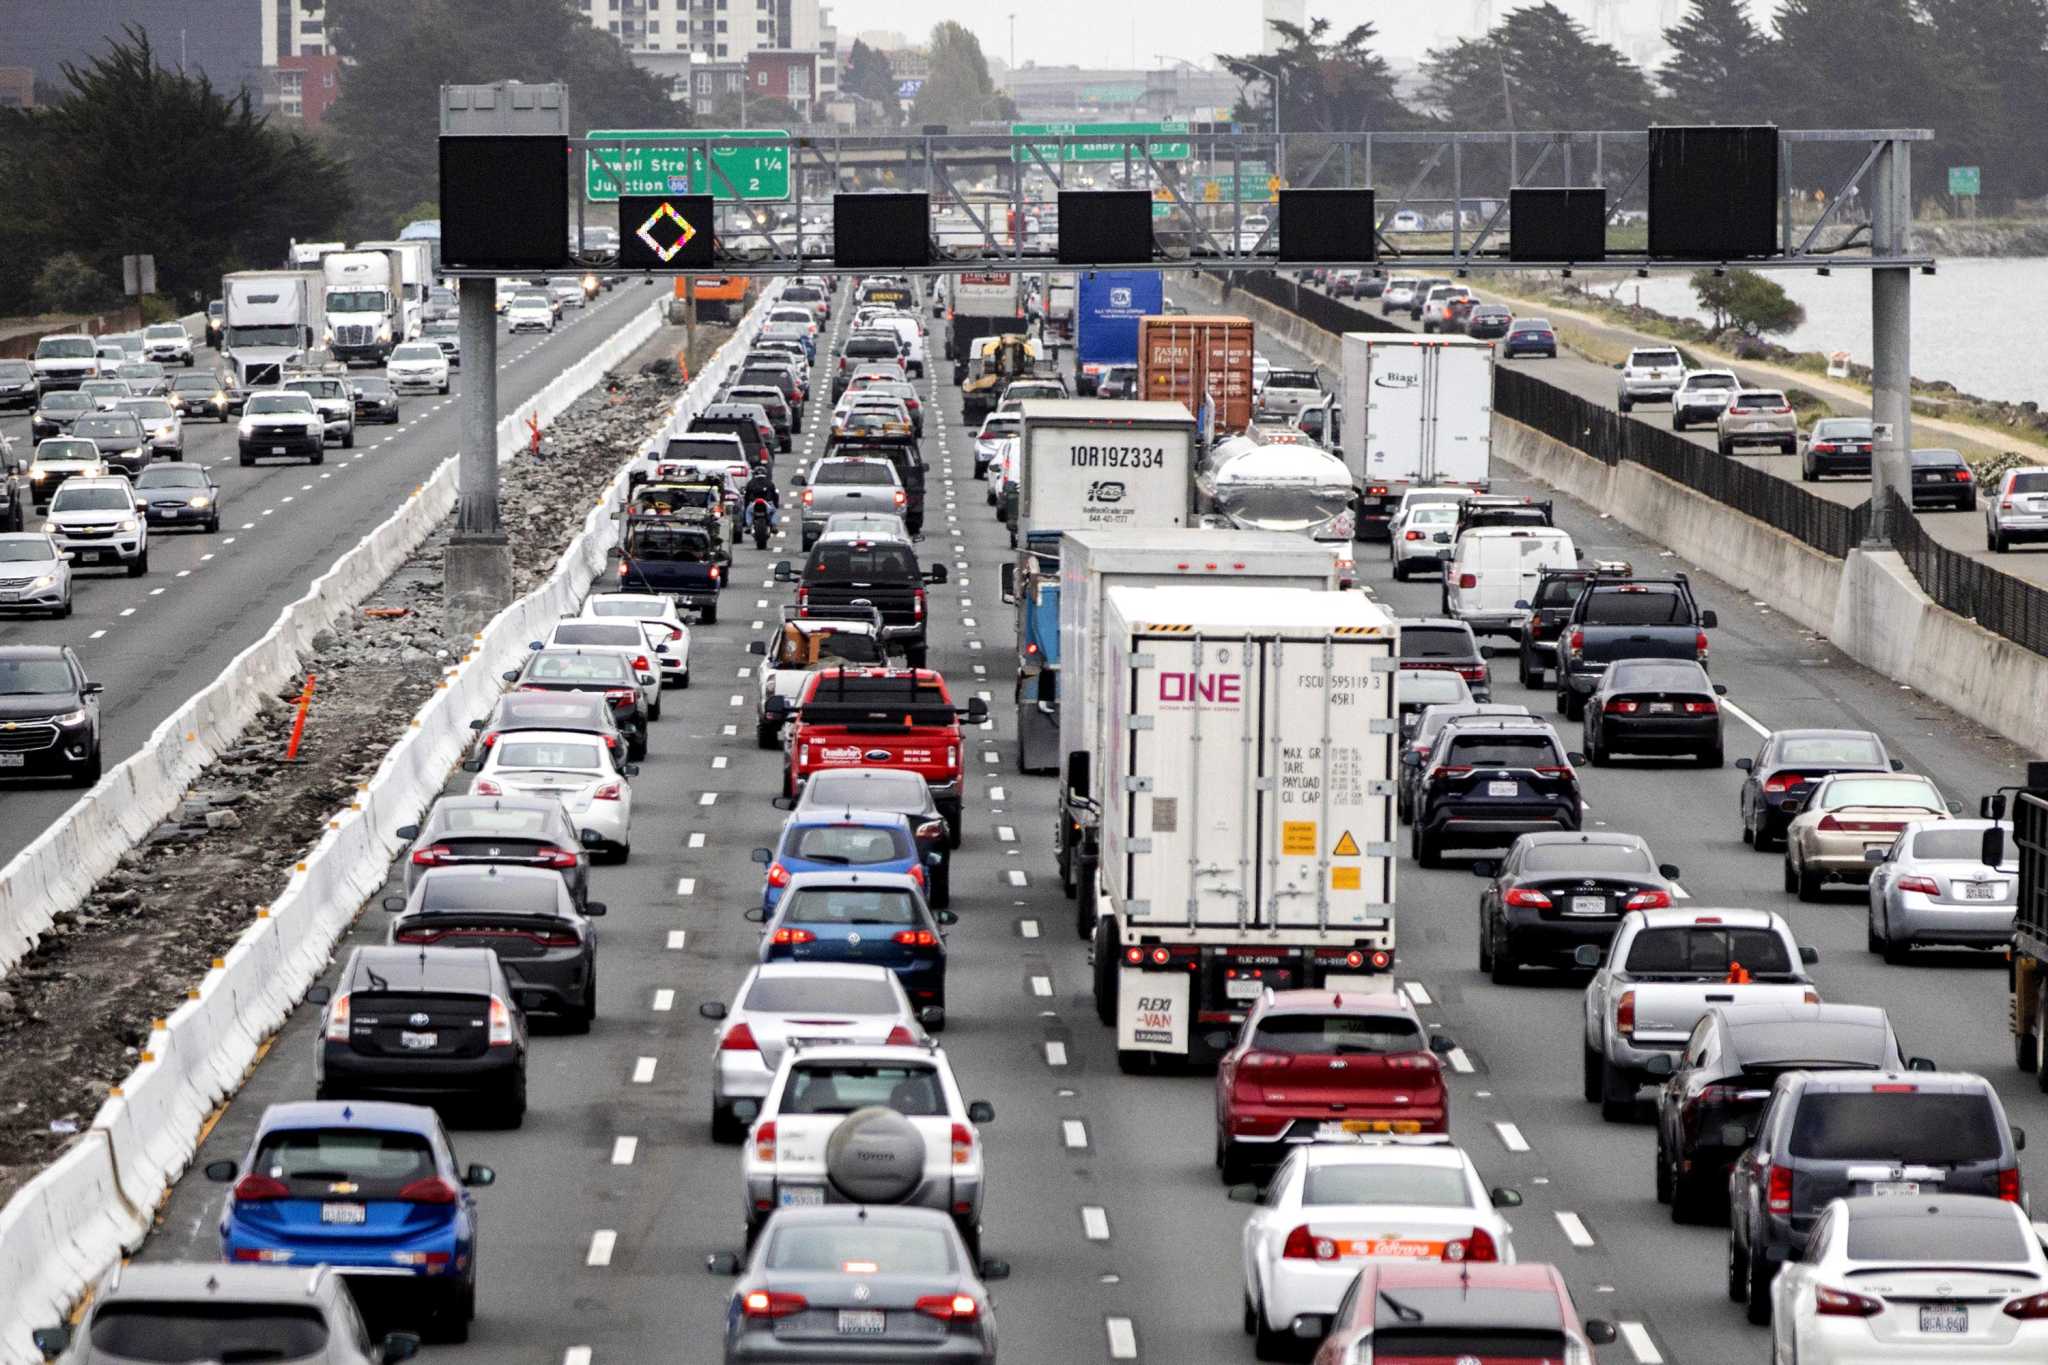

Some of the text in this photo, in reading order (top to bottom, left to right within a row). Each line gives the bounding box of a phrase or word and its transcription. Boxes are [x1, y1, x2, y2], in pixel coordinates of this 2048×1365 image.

[651, 159, 702, 171] Stret
[749, 178, 760, 191] 2
[1387, 372, 1418, 384] Biagi
[1070, 446, 1163, 468] 10R19Z334
[1159, 672, 1240, 703] ONE
[1298, 675, 1324, 688] FSCU
[1375, 676, 1381, 689] 3
[1283, 747, 1321, 759] MAX GR
[1283, 761, 1304, 773] TARE
[1282, 776, 1320, 789] PAYLOAD
[1282, 791, 1321, 803] CU CAP
[857, 1151, 896, 1160] TOYOTA
